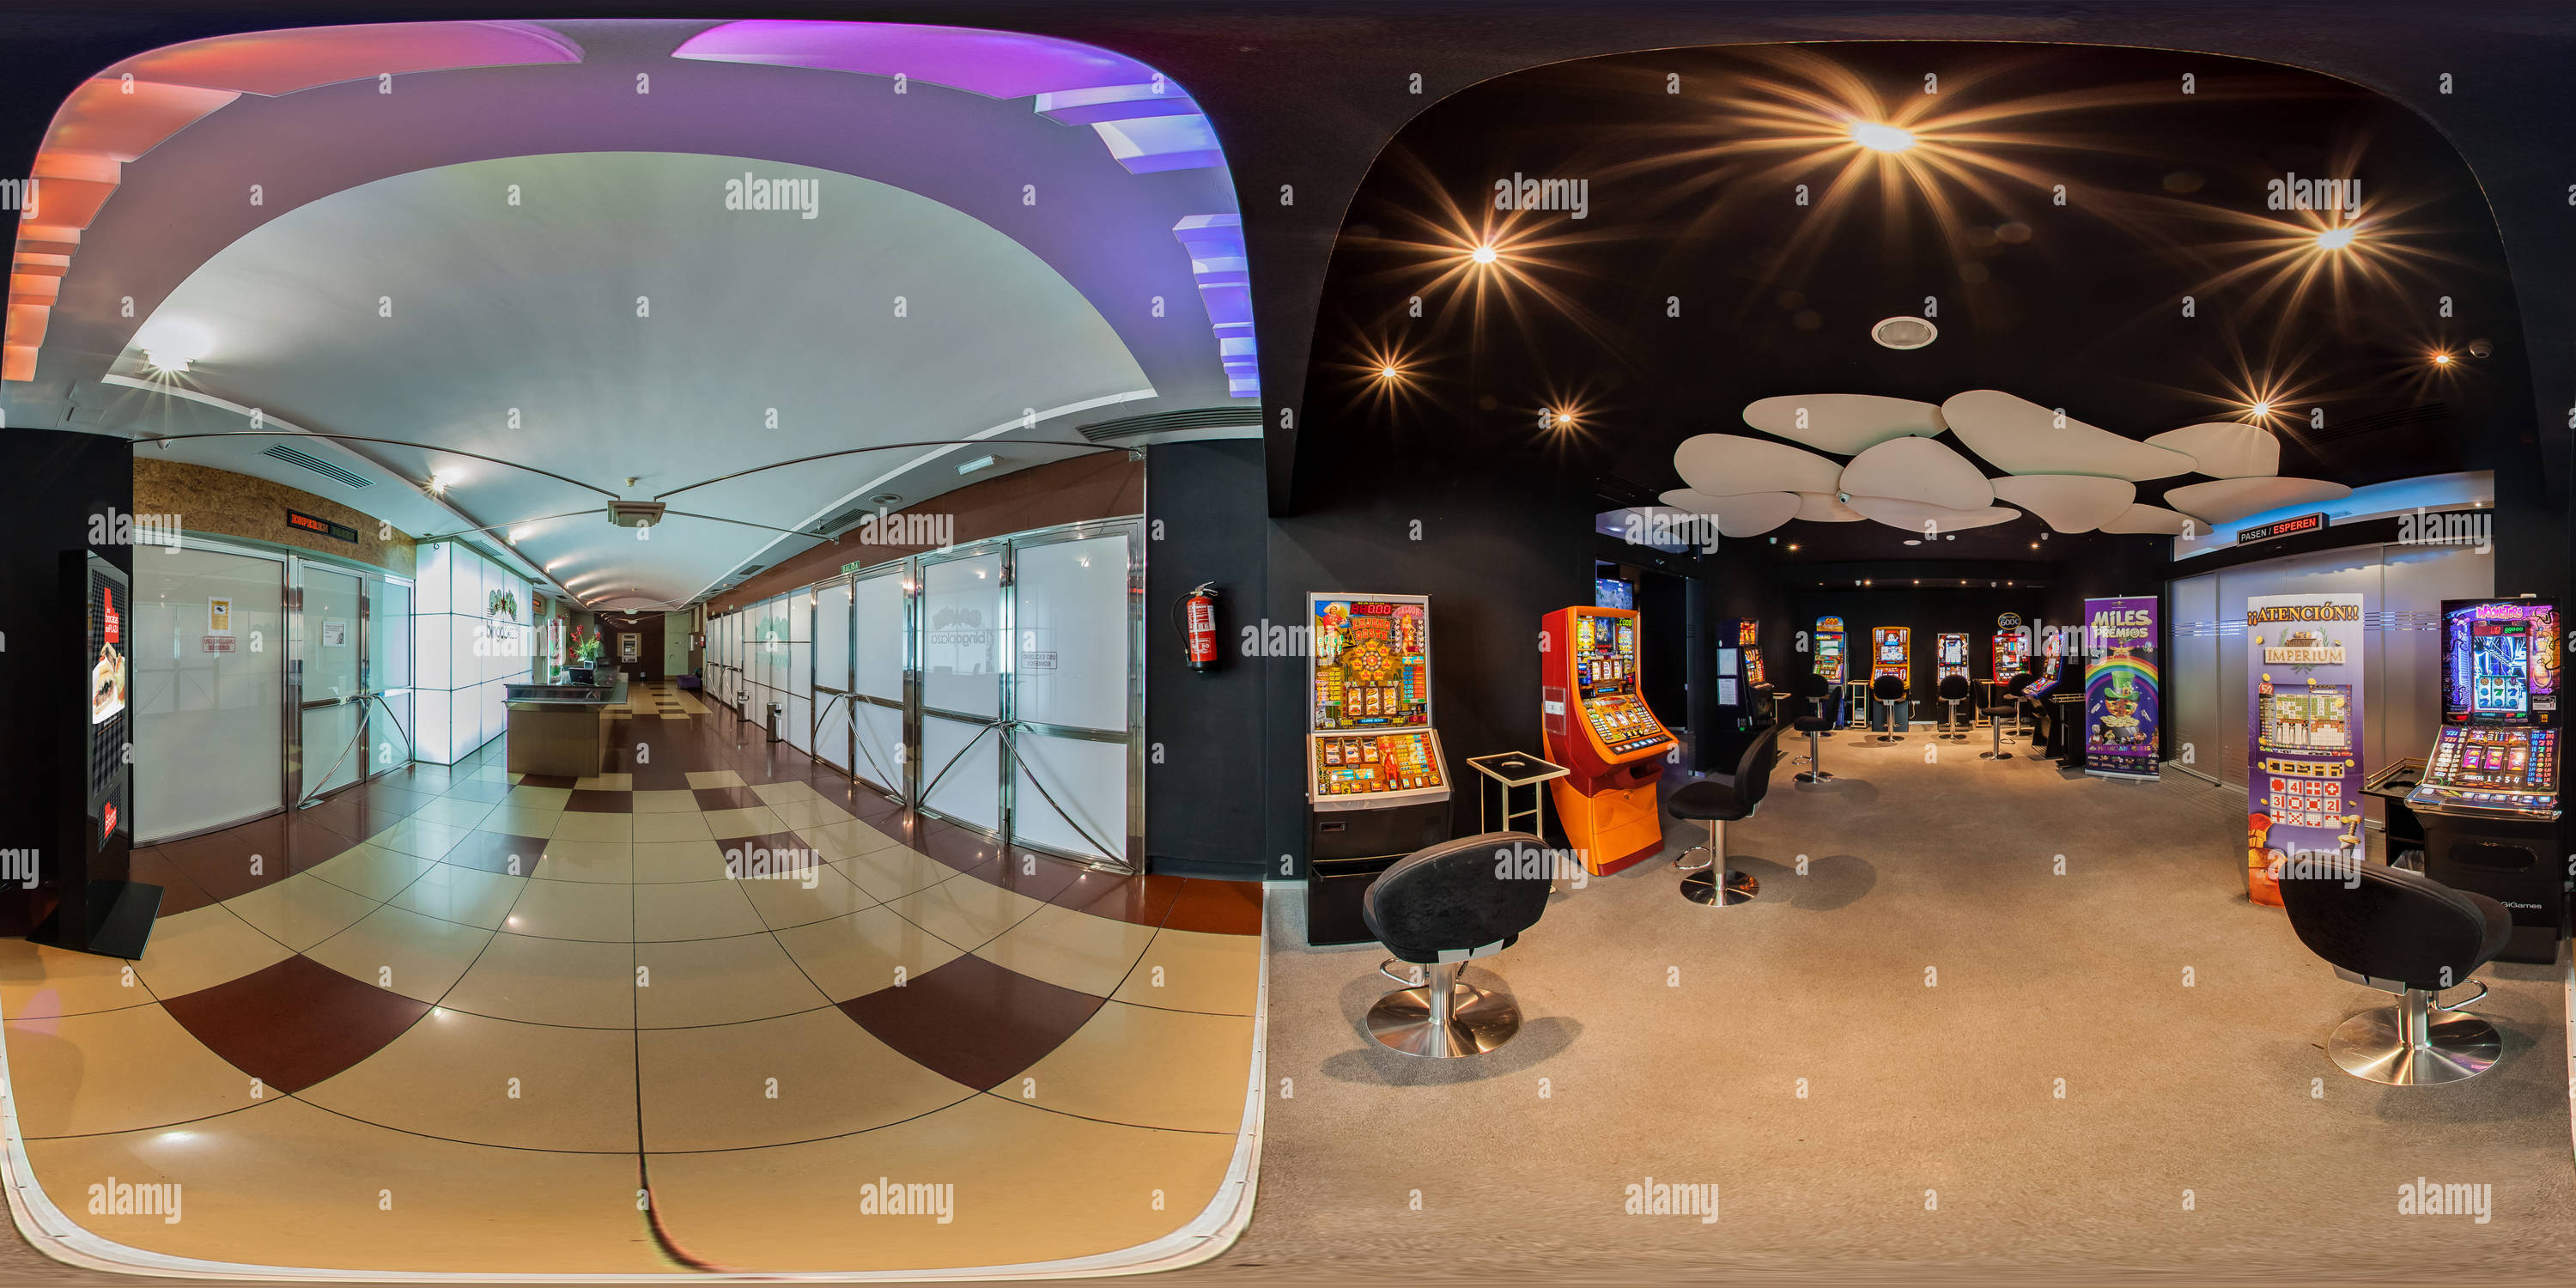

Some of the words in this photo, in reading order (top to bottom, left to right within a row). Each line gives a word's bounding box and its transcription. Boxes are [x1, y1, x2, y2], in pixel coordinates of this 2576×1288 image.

[2240, 528, 2267, 542] PASEN
[2268, 527, 2272, 537] /
[2273, 516, 2317, 535] ESPEREN
[2247, 601, 2360, 626] ¡¡ATENCIÓN!!
[1352, 617, 1391, 630] LEJANO
[1356, 628, 1388, 641] OESTE
[2093, 627, 2148, 639] PREMIOS
[2268, 649, 2343, 661] IMPERIUM
